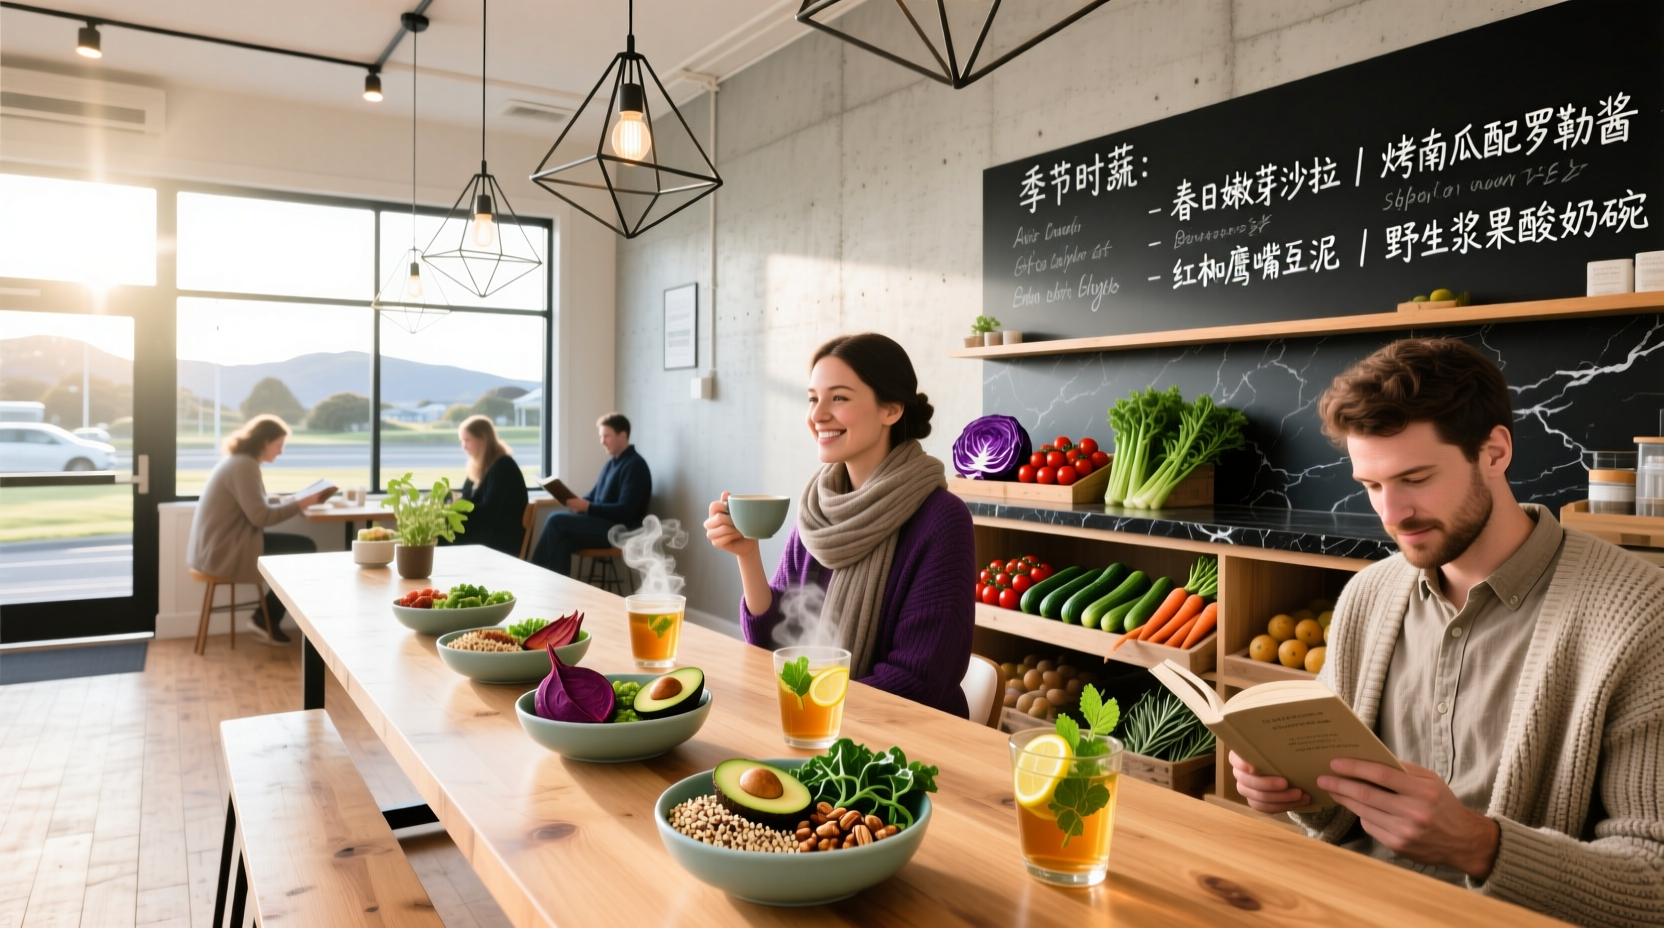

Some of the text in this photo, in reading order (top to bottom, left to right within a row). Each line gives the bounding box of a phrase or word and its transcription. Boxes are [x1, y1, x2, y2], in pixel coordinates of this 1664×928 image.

[1170, 156, 1341, 222] 春日嫩芽沙拉
[1380, 91, 1639, 179] 烤南瓜配罗勒酱
[1385, 188, 1649, 263] 野生浆果酸奶碗
